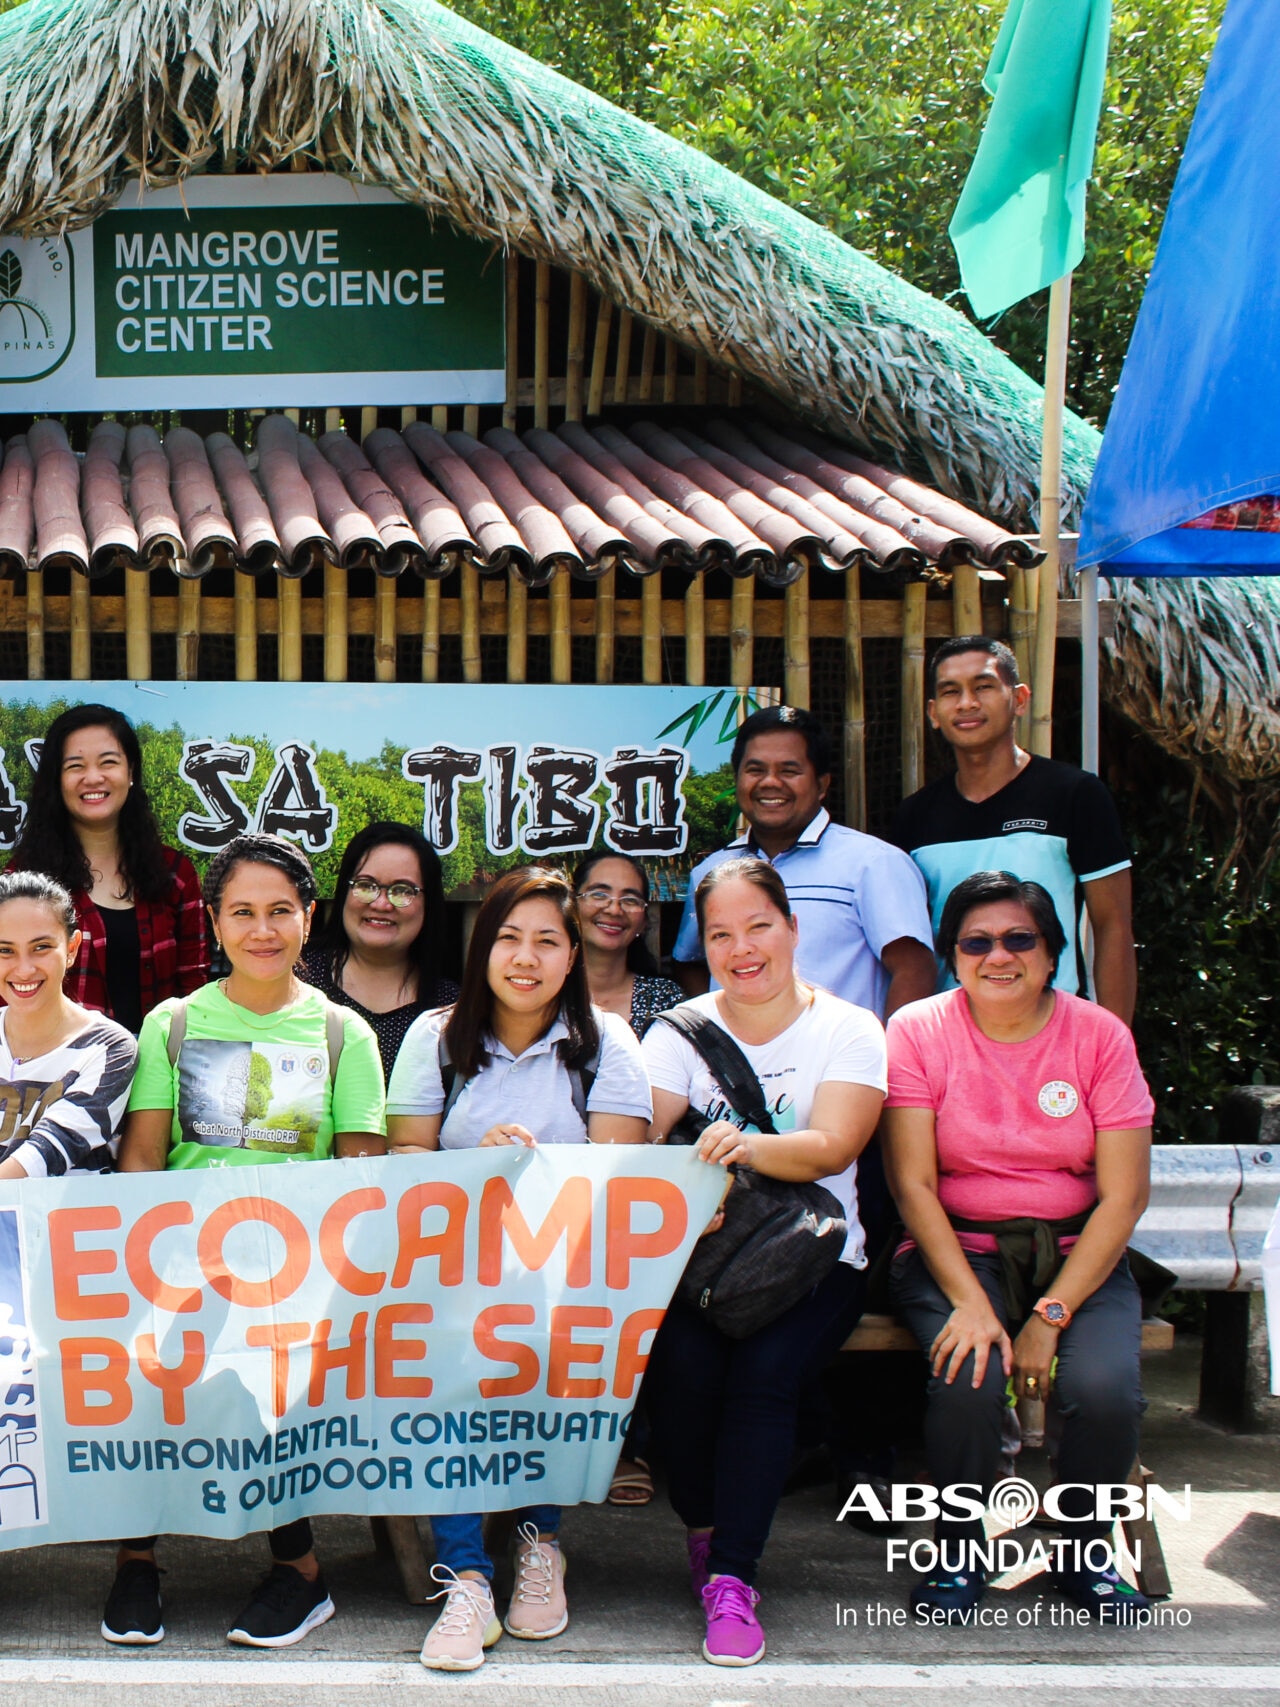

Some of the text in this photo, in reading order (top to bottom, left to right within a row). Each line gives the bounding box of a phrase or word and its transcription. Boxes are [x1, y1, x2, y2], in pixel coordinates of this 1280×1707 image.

[115, 229, 339, 268] MANGROVE
[115, 269, 445, 311] CITIZEN SCIENCE
[115, 315, 273, 353] CENTER
[179, 740, 337, 853] SA
[403, 742, 687, 855] TIBO
[217, 1124, 241, 1136] North
[243, 1126, 275, 1141] District
[48, 1176, 688, 1321] ECOCAMP
[58, 1330, 206, 1427] BY
[246, 1303, 433, 1418] THE
[67, 1413, 378, 1473] ENVIRONMENTAL,
[203, 1450, 545, 1513] & OUTDOOR CAMPS
